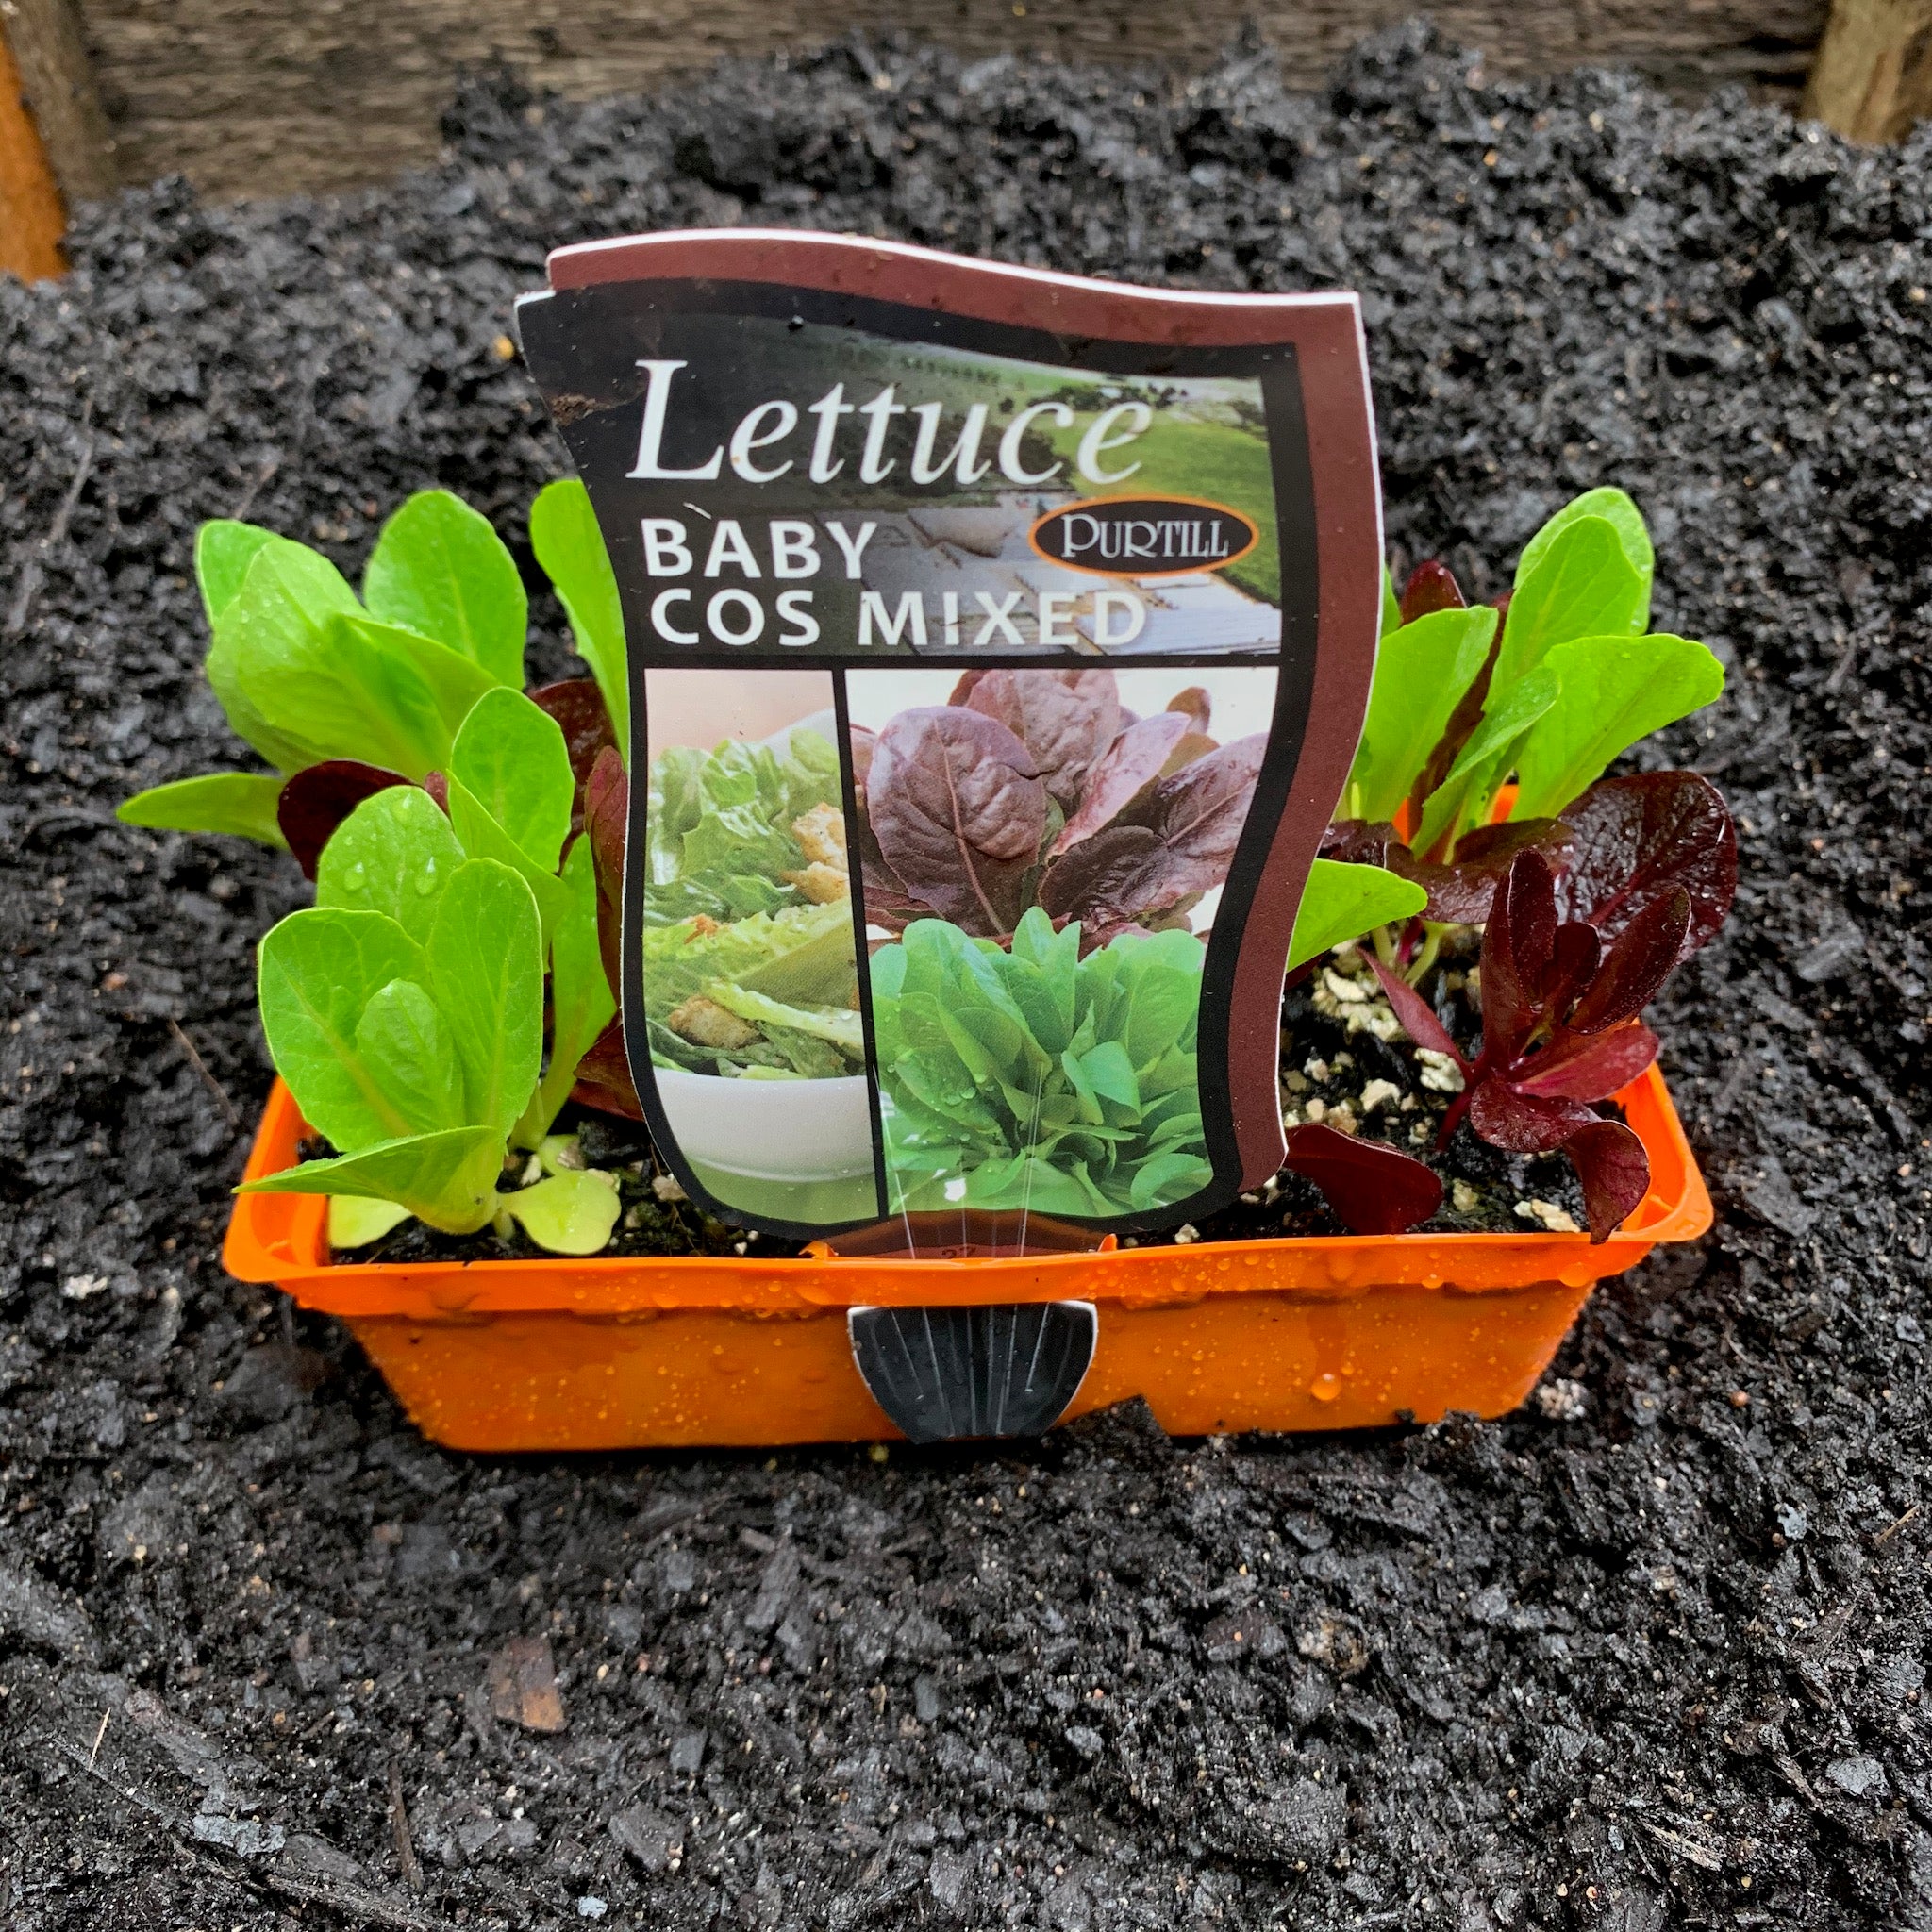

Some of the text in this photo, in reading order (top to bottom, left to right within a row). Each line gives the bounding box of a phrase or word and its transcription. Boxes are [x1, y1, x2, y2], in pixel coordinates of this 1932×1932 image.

[625, 358, 1153, 485] Lettuce
[641, 518, 877, 579] BABY
[1061, 513, 1229, 558] PURTILL
[650, 588, 1145, 646] COS MIXED
